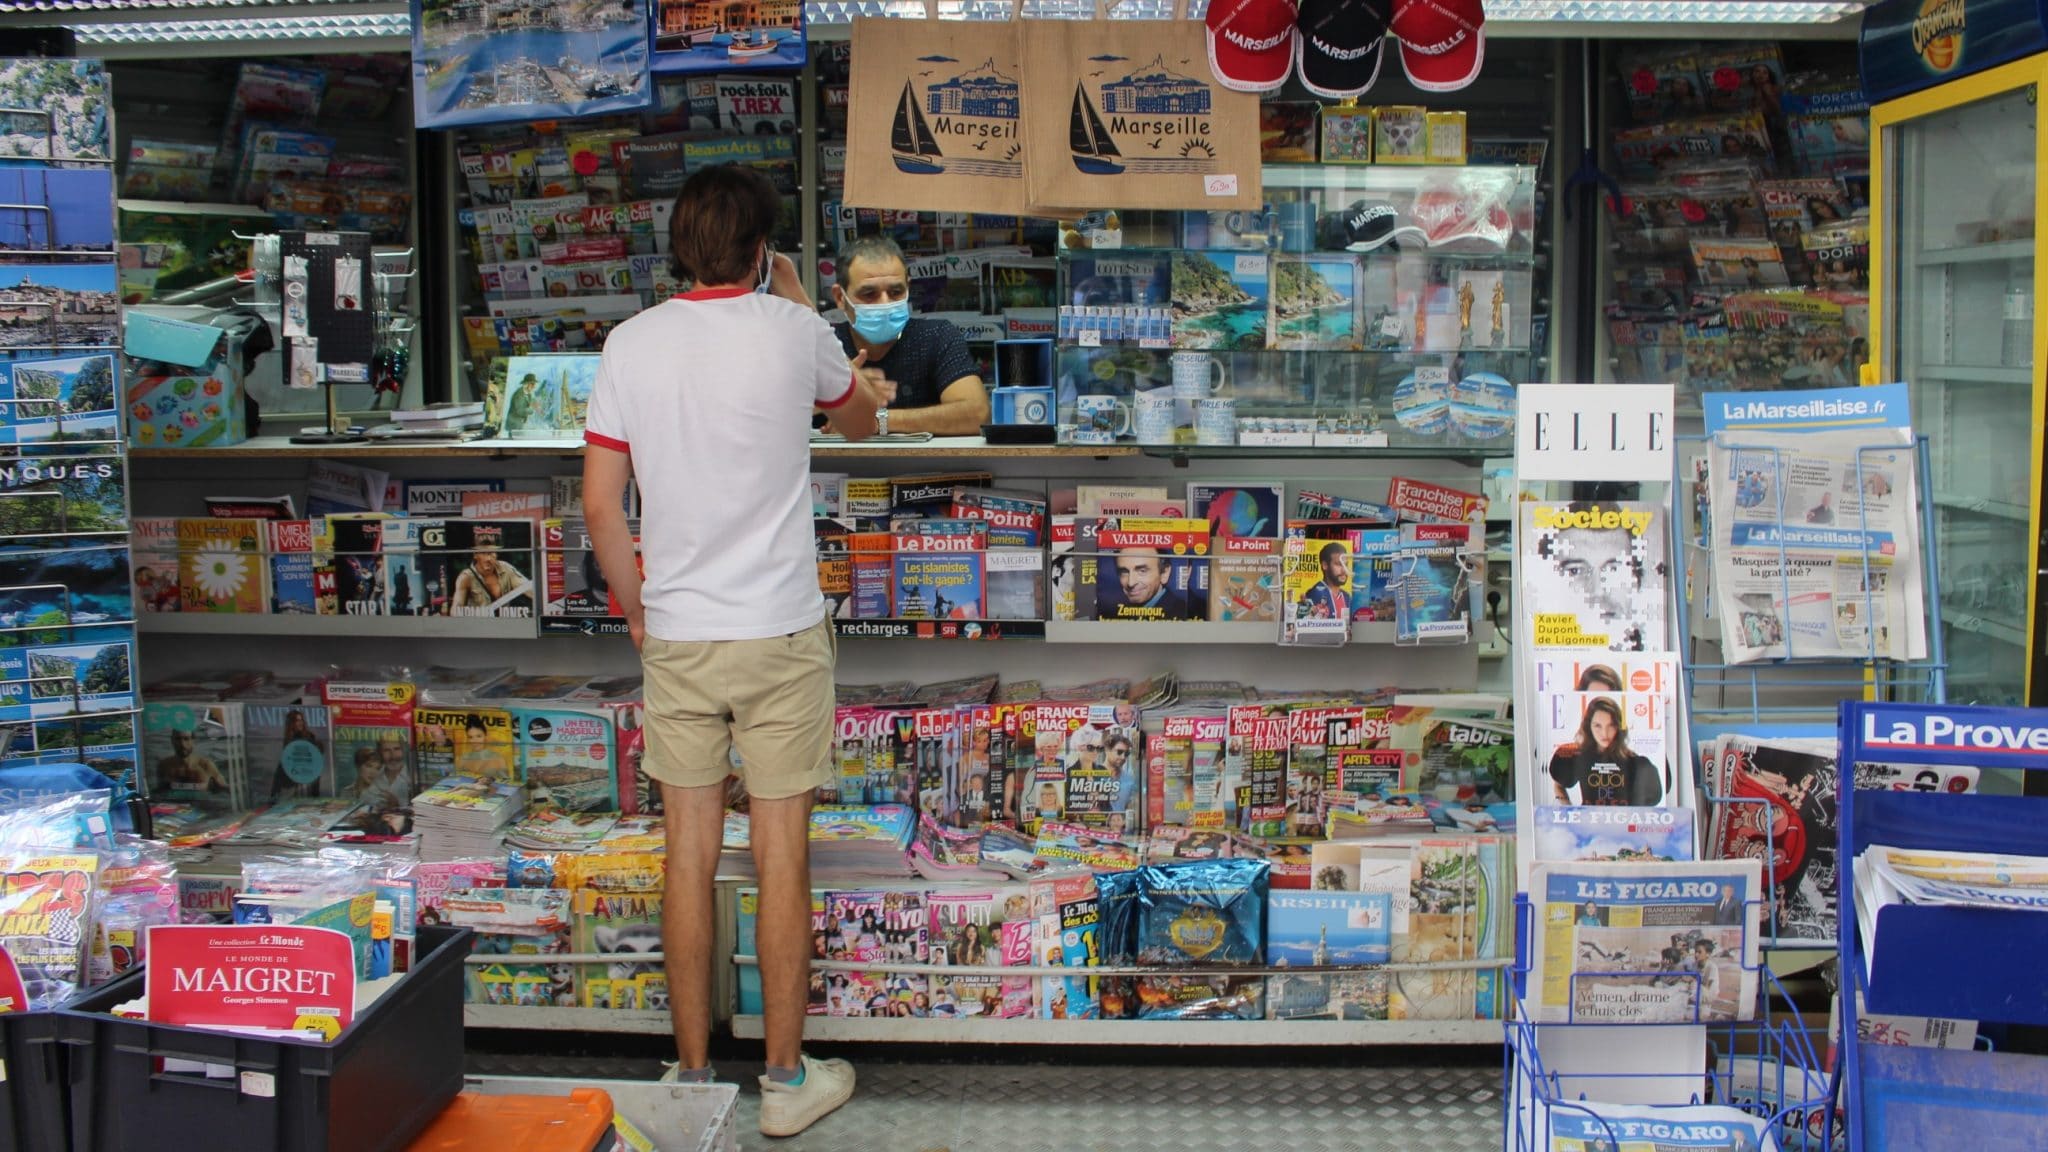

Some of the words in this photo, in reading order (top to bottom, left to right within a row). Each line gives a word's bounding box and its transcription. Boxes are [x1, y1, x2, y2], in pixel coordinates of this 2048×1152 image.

[1911, 0, 1966, 54] ORANGINA
[1400, 29, 1466, 55] ARSEILLE
[1110, 116, 1210, 136] Marseille
[1008, 318, 1054, 333] Beaux
[1723, 402, 1746, 420] La
[1746, 399, 1869, 419] Marseillaise
[1532, 412, 1665, 451] ELLE
[902, 488, 927, 500] TOP
[1397, 481, 1464, 506] Franchise
[475, 499, 528, 516] NEON
[1396, 493, 1464, 519] Concept(s)
[957, 507, 979, 521] Le
[982, 509, 1034, 529] Point
[1533, 505, 1654, 536] Society
[1111, 534, 1172, 546] VALEURS
[1418, 530, 1450, 540] Secours
[896, 536, 919, 551] Le
[921, 534, 975, 551] Point
[1228, 540, 1241, 550] Le
[1242, 540, 1271, 551] Point
[904, 561, 921, 573] Les
[923, 561, 971, 574] islamistes
[989, 555, 1039, 566] MAIGRET
[1731, 557, 1779, 570] Masques
[1793, 558, 1833, 571] quand
[1750, 567, 1761, 578] la
[901, 573, 933, 586] ont-ils
[935, 573, 965, 588] gagné
[1117, 604, 1165, 617] Zemmour,
[1537, 615, 1574, 624] Xavier
[842, 622, 909, 638] recharges
[942, 626, 958, 636] SFR
[1537, 625, 1579, 636] Dupont
[1537, 635, 1552, 645] de
[329, 685, 351, 694] OFFRE
[352, 684, 387, 695] SPÉCIALE
[425, 711, 507, 728] ENTRVUE
[1036, 706, 1088, 719] FRANCE
[1232, 708, 1260, 721] Reines
[555, 727, 604, 737] MARSEILLE
[1036, 719, 1068, 731] MAG
[1864, 713, 1917, 745] La
[1450, 724, 1503, 746] table
[1343, 754, 1371, 765] ARTS
[1373, 754, 1400, 765] CITY
[1069, 776, 1121, 793] Mariés
[1069, 801, 1094, 810] Johnny
[1552, 810, 1581, 824] LE
[1589, 811, 1675, 825] FIGARO
[25, 858, 51, 868] JEUX
[1576, 881, 1612, 899] LE
[1613, 880, 1718, 900] FIGARO
[1063, 916, 1081, 927] des
[209, 938, 222, 947] Une
[223, 938, 256, 947] collection
[258, 935, 271, 947] Le
[271, 935, 305, 948] Monde
[240, 955, 273, 964] MONDE
[171, 966, 336, 997] MAIGRET
[223, 996, 255, 1006] Georges
[255, 996, 289, 1005] Simenon
[1580, 990, 1626, 1005] Yemen,
[1628, 989, 1671, 1004] drame
[1588, 1003, 1616, 1017] huis
[1618, 1003, 1644, 1017] clos
[1618, 1121, 1729, 1141] FIGARO
